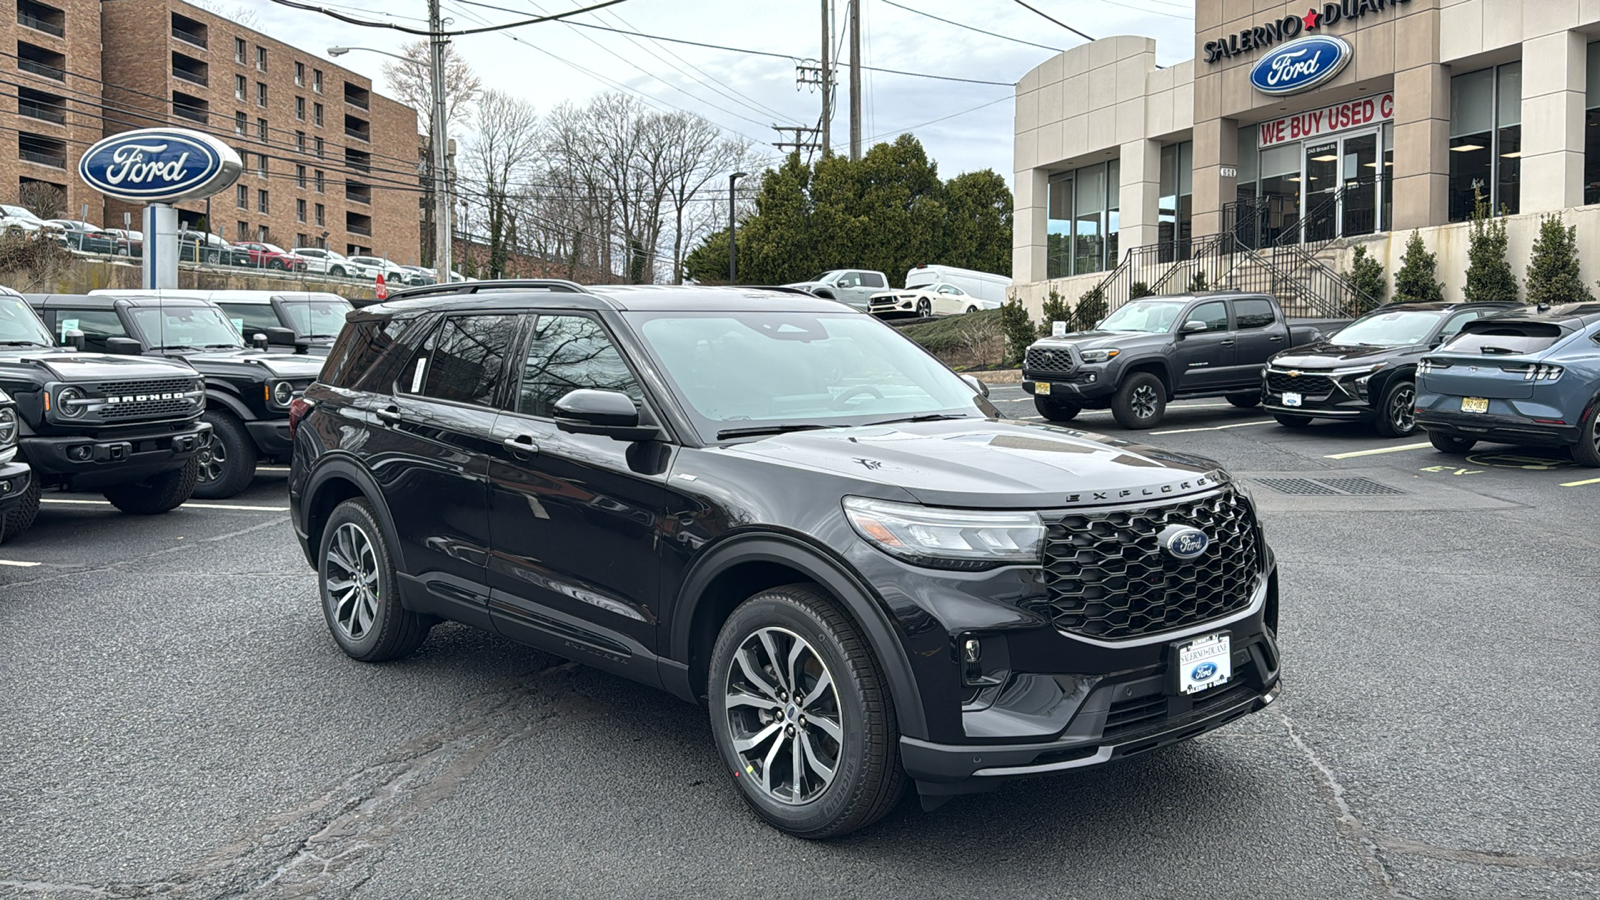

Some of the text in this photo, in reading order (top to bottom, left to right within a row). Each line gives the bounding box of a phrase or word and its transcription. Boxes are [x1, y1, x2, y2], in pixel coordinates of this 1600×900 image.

[1203, 0, 1413, 63] SALERNO DUA
[1267, 48, 1321, 85] Ford
[1260, 119, 1286, 146] WE
[1290, 110, 1324, 139] BUY
[1327, 99, 1375, 131] USED
[106, 144, 190, 184] Ford
[108, 393, 183, 403] BRONCO
[1066, 474, 1218, 503] EXPLORER
[1180, 534, 1202, 553] Ford
[1195, 665, 1213, 680] Ford
[822, 759, 857, 817] MICHELIN
